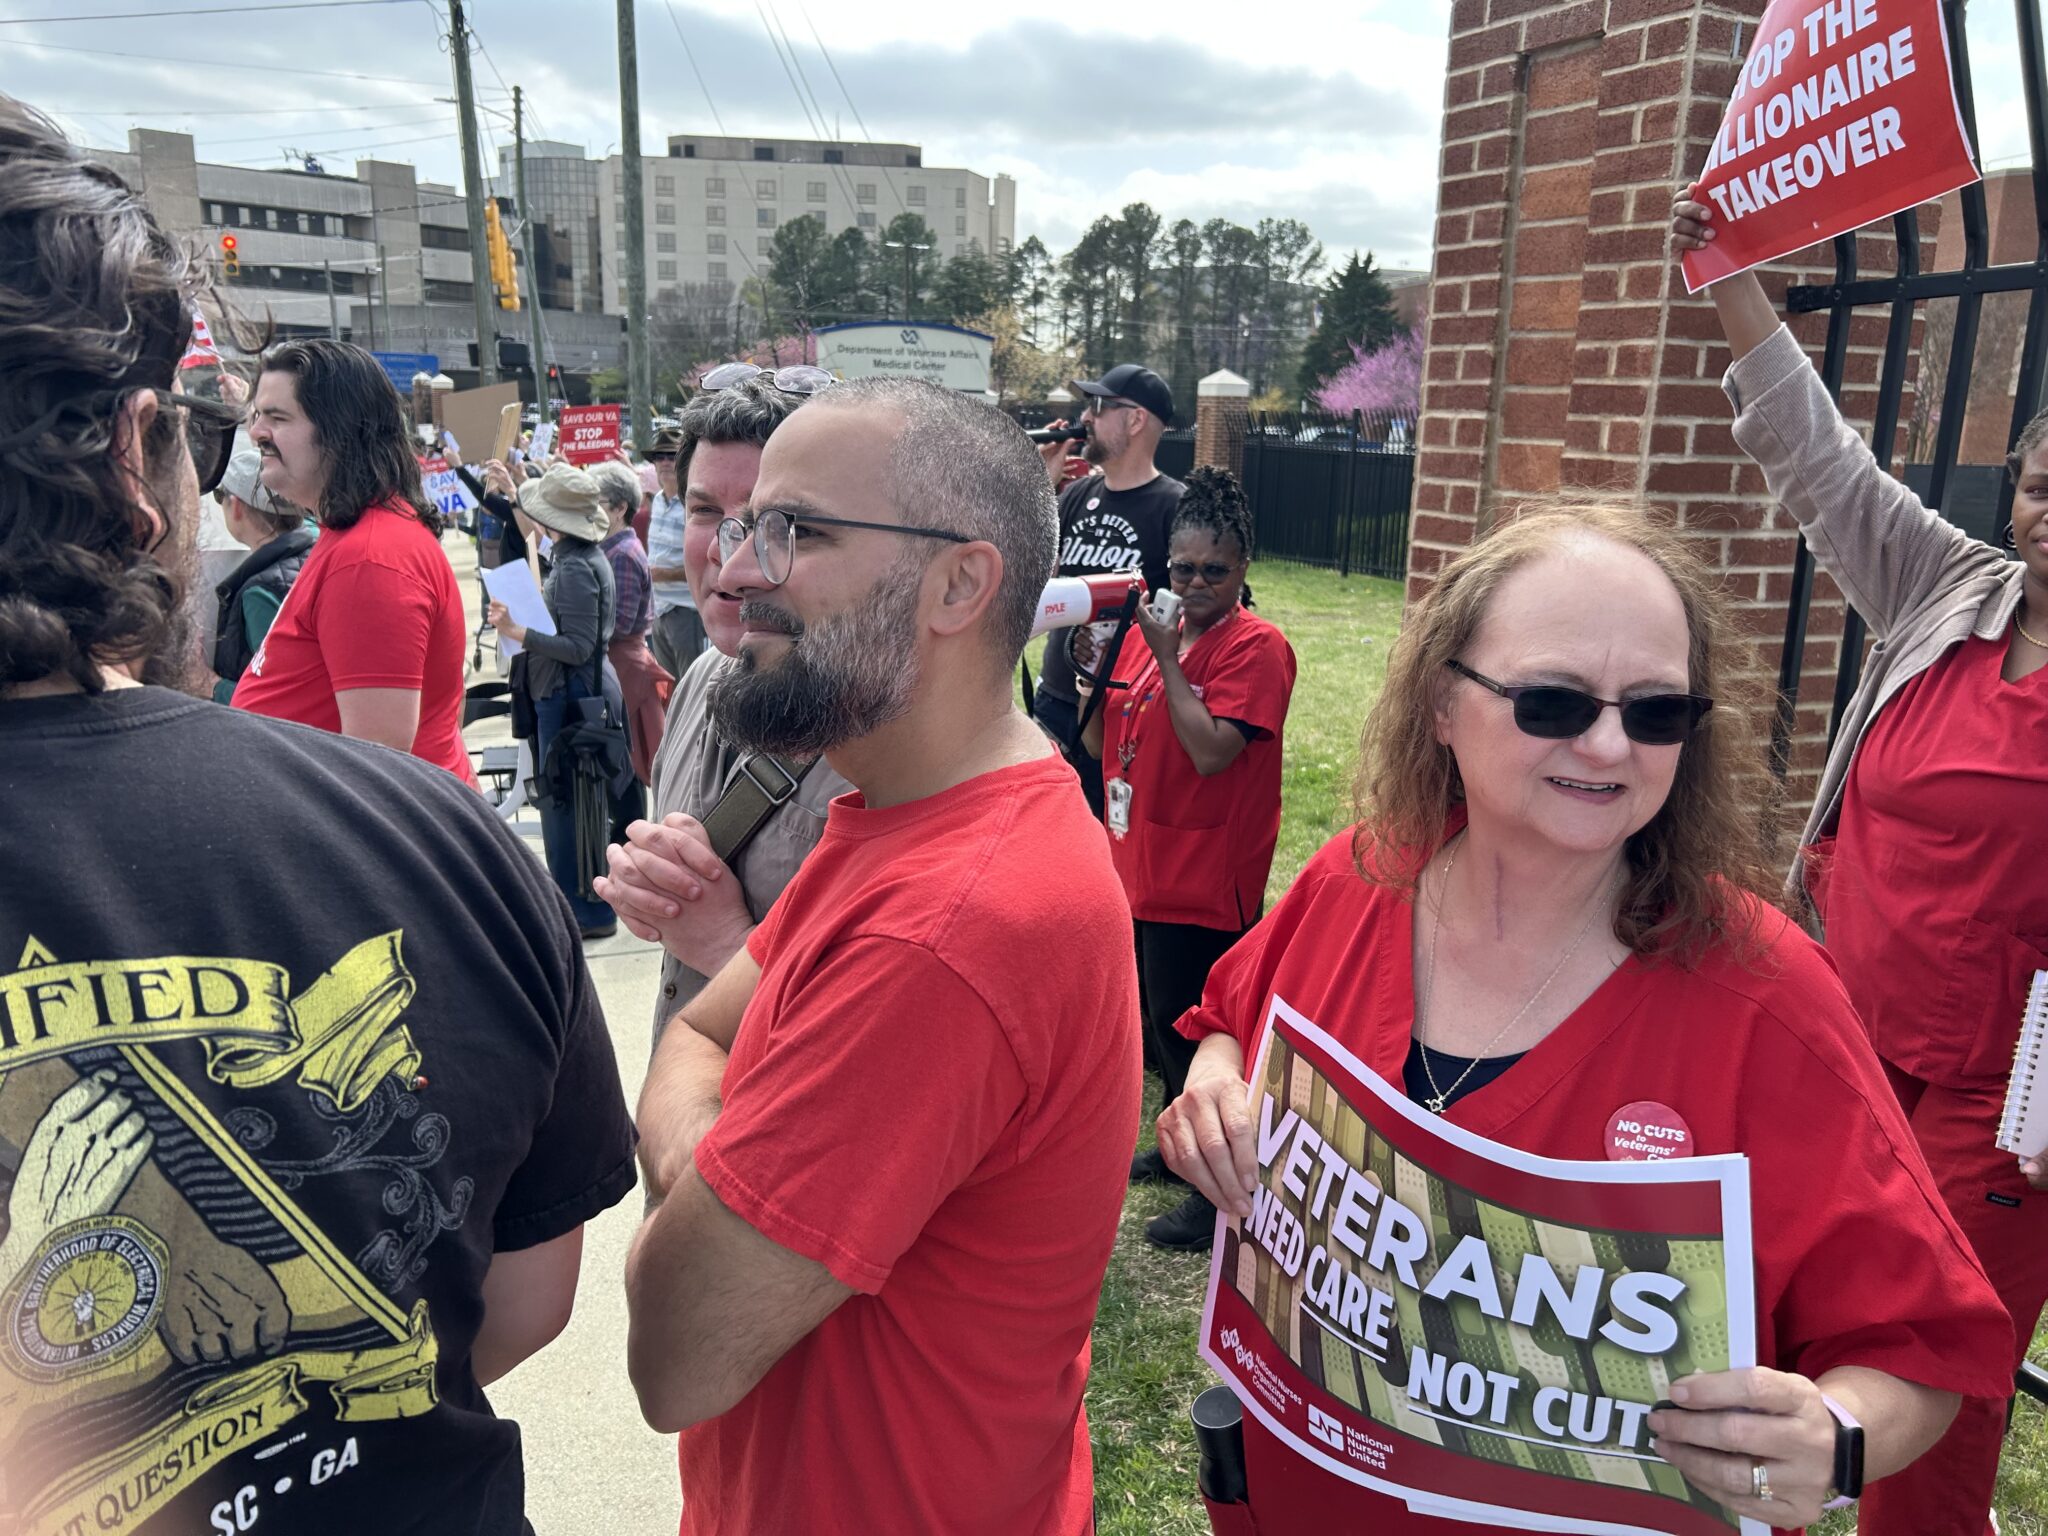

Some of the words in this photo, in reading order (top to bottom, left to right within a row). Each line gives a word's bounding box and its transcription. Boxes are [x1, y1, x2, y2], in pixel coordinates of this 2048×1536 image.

[1731, 28, 1796, 104] TOP
[1803, 0, 1879, 57] THE
[1708, 26, 1917, 171] ILLIONAIRE
[1708, 106, 1906, 222] TAKEOVER
[837, 344, 892, 355] Department
[895, 347, 904, 356] of
[907, 348, 947, 358] Veterans
[948, 350, 980, 360] Affairs
[873, 359, 911, 369] Medical
[913, 361, 946, 371] Center
[563, 412, 584, 425] SAVE
[585, 412, 604, 423] OUR
[605, 411, 617, 421] VA
[562, 441, 576, 451] THE
[577, 439, 616, 450] BLEEDING
[574, 427, 603, 441] STOP
[430, 470, 456, 489] SAV
[436, 493, 467, 513] VA
[1071, 515, 1097, 535] IT'S
[1101, 513, 1139, 544] BETTER
[1060, 537, 1144, 570] Union
[1045, 602, 1066, 616] PYLE
[1616, 1119, 1642, 1134] NO
[1644, 1124, 1686, 1142] CUTS
[1636, 1134, 1647, 1142] to
[1257, 1091, 1687, 1353] VETERANS
[1244, 1182, 1305, 1278] NEED
[1304, 1244, 1395, 1350] CARE
[1254, 1364, 1286, 1406] Organizing
[1256, 1353, 1278, 1385] National
[1278, 1378, 1302, 1405] Nurses
[1252, 1375, 1286, 1414] Committee
[1407, 1345, 1519, 1425] NOT
[1533, 1386, 1656, 1449] CUT
[1346, 1425, 1394, 1454] National
[1347, 1437, 1386, 1460] Nurses
[95, 1403, 264, 1530] QUESTION
[1348, 1447, 1386, 1470] United
[210, 1484, 259, 1536] SC
[309, 1437, 359, 1486] GA
